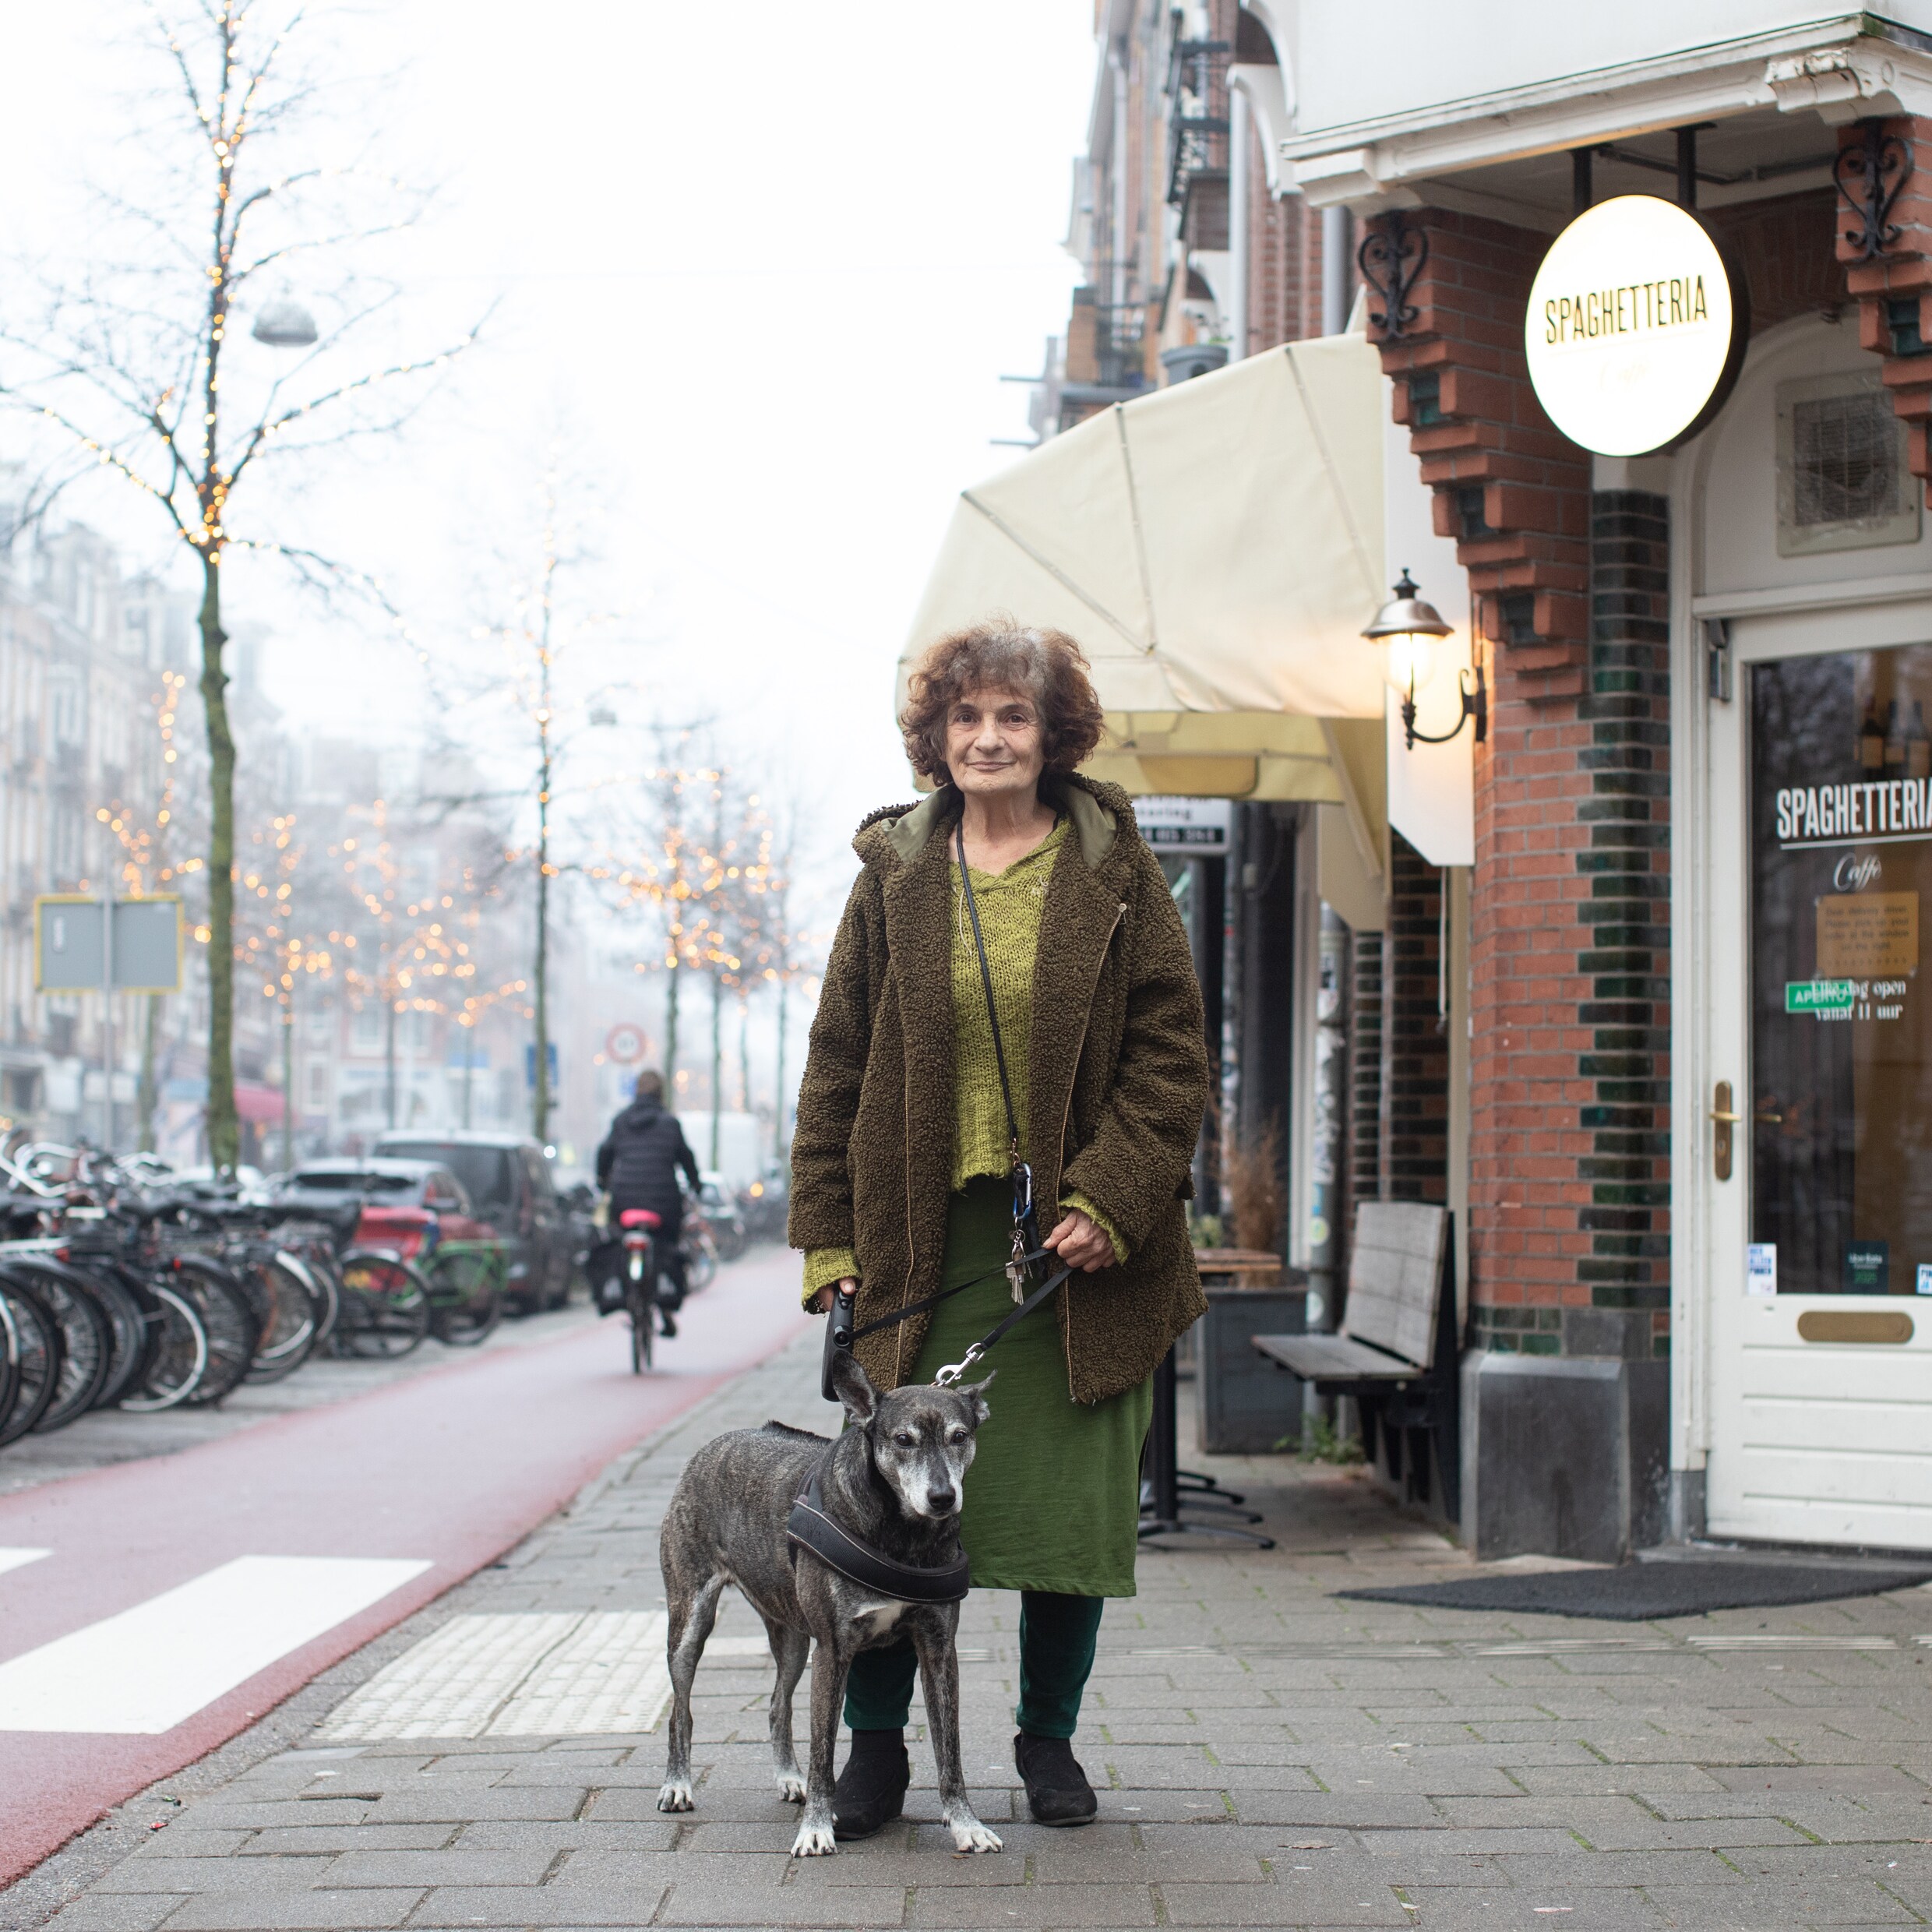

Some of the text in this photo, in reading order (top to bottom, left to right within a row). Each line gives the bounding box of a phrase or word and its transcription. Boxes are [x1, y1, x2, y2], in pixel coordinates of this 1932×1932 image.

[1545, 275, 1708, 344] SPAGHETTERIA
[1872, 980, 1906, 1000] open
[1877, 1004, 1903, 1020] uur
